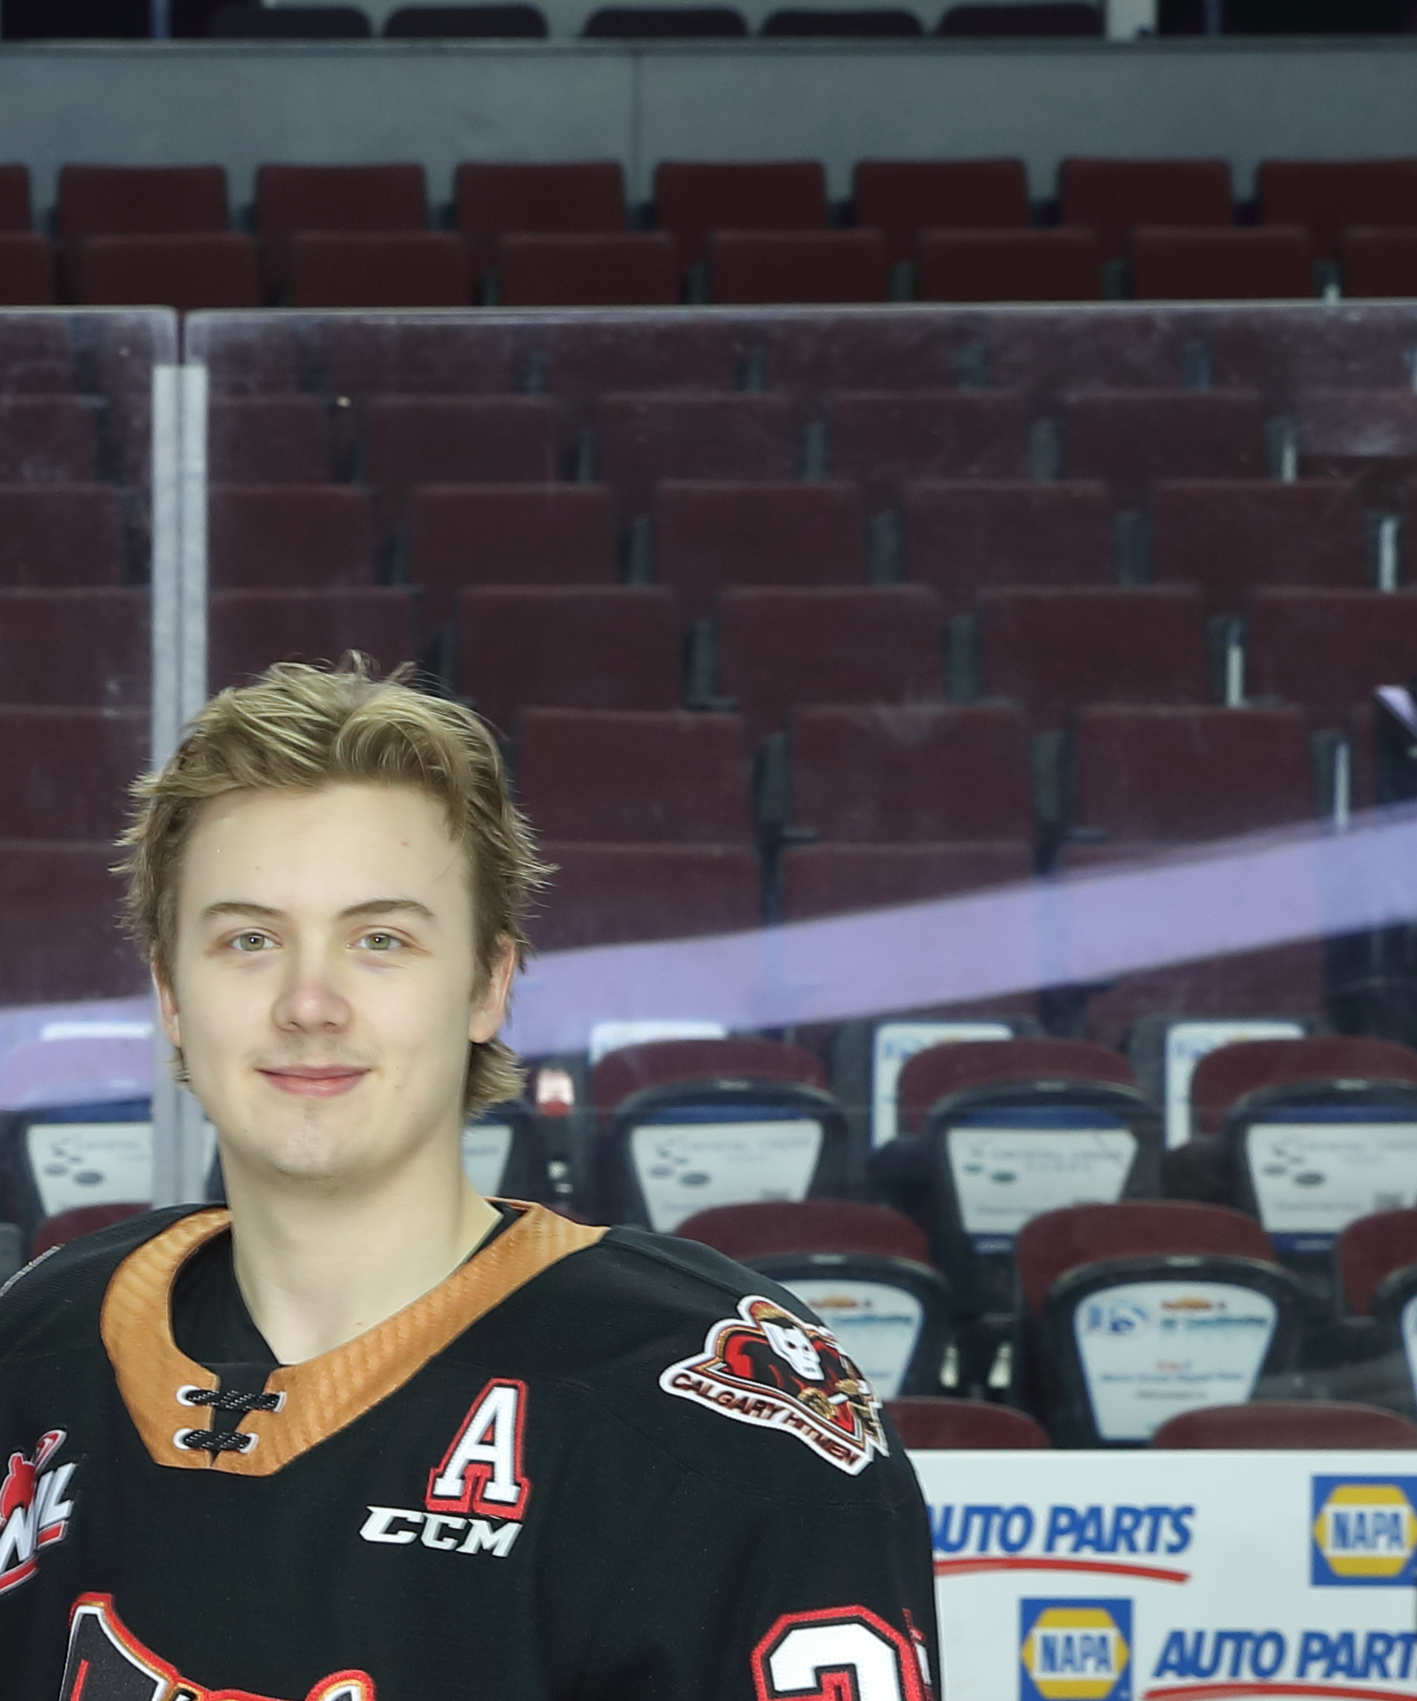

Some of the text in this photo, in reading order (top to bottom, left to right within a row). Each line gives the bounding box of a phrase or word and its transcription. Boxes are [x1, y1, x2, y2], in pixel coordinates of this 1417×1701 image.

[670, 1373, 785, 1421] CALGARY
[425, 1377, 532, 1520] A
[359, 1506, 523, 1557] CCM
[1044, 1506, 1194, 1554] PARTS
[1333, 1511, 1405, 1550] NAPA
[1040, 1634, 1111, 1673] NAPA
[1153, 1631, 1417, 1679] AUTO PART
